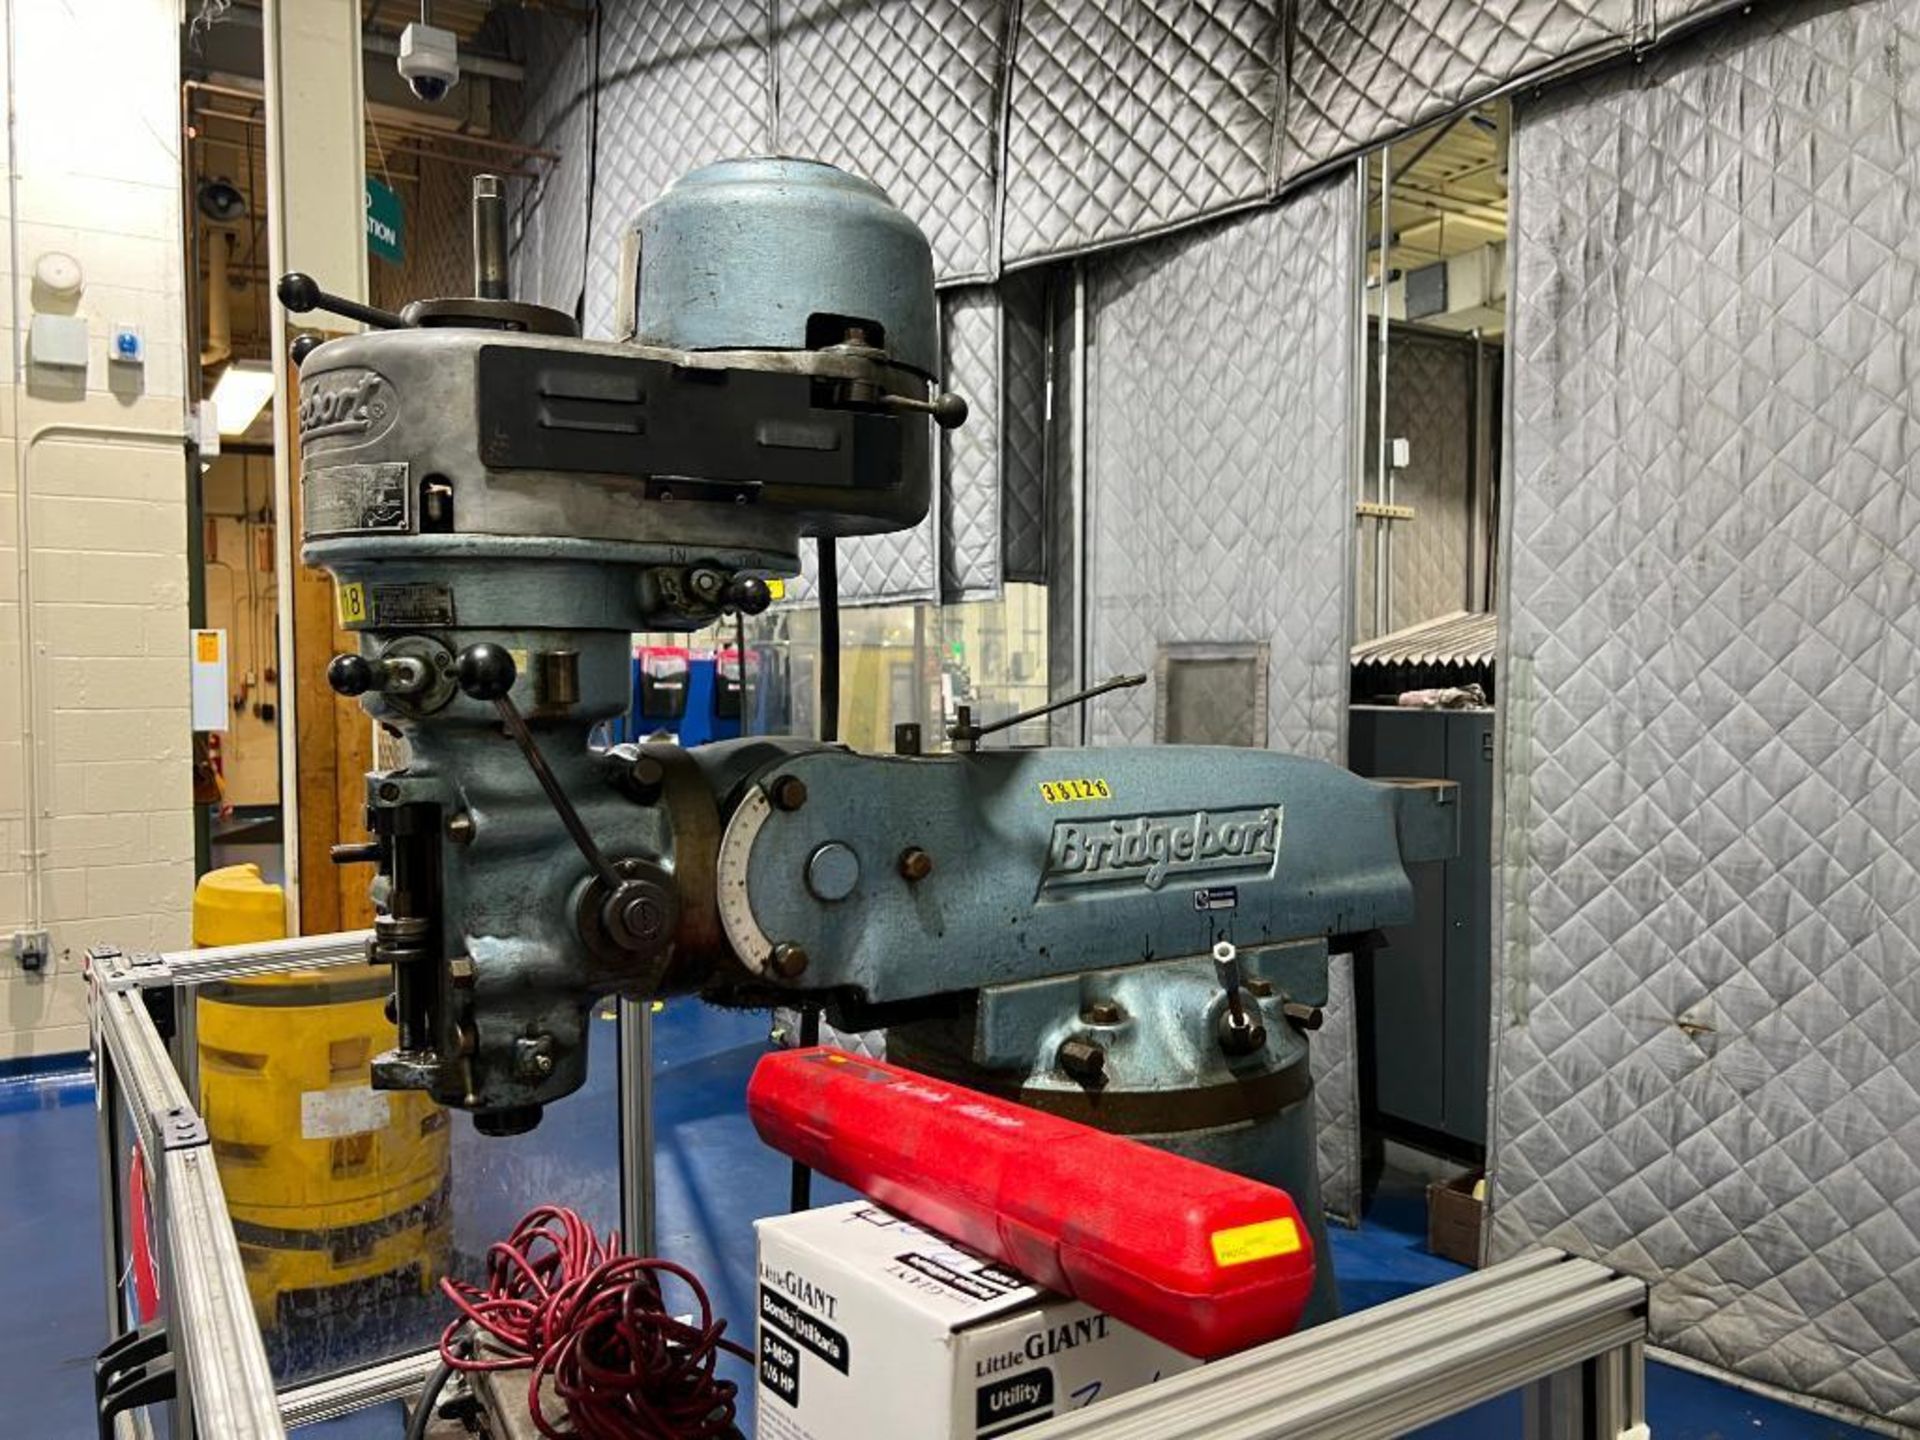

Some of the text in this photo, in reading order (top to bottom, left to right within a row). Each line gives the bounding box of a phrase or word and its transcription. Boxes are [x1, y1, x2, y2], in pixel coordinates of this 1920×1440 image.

[1042, 780, 1108, 801] 38126
[780, 1371, 796, 1393] HP
[990, 1381, 1041, 1412] Utility
